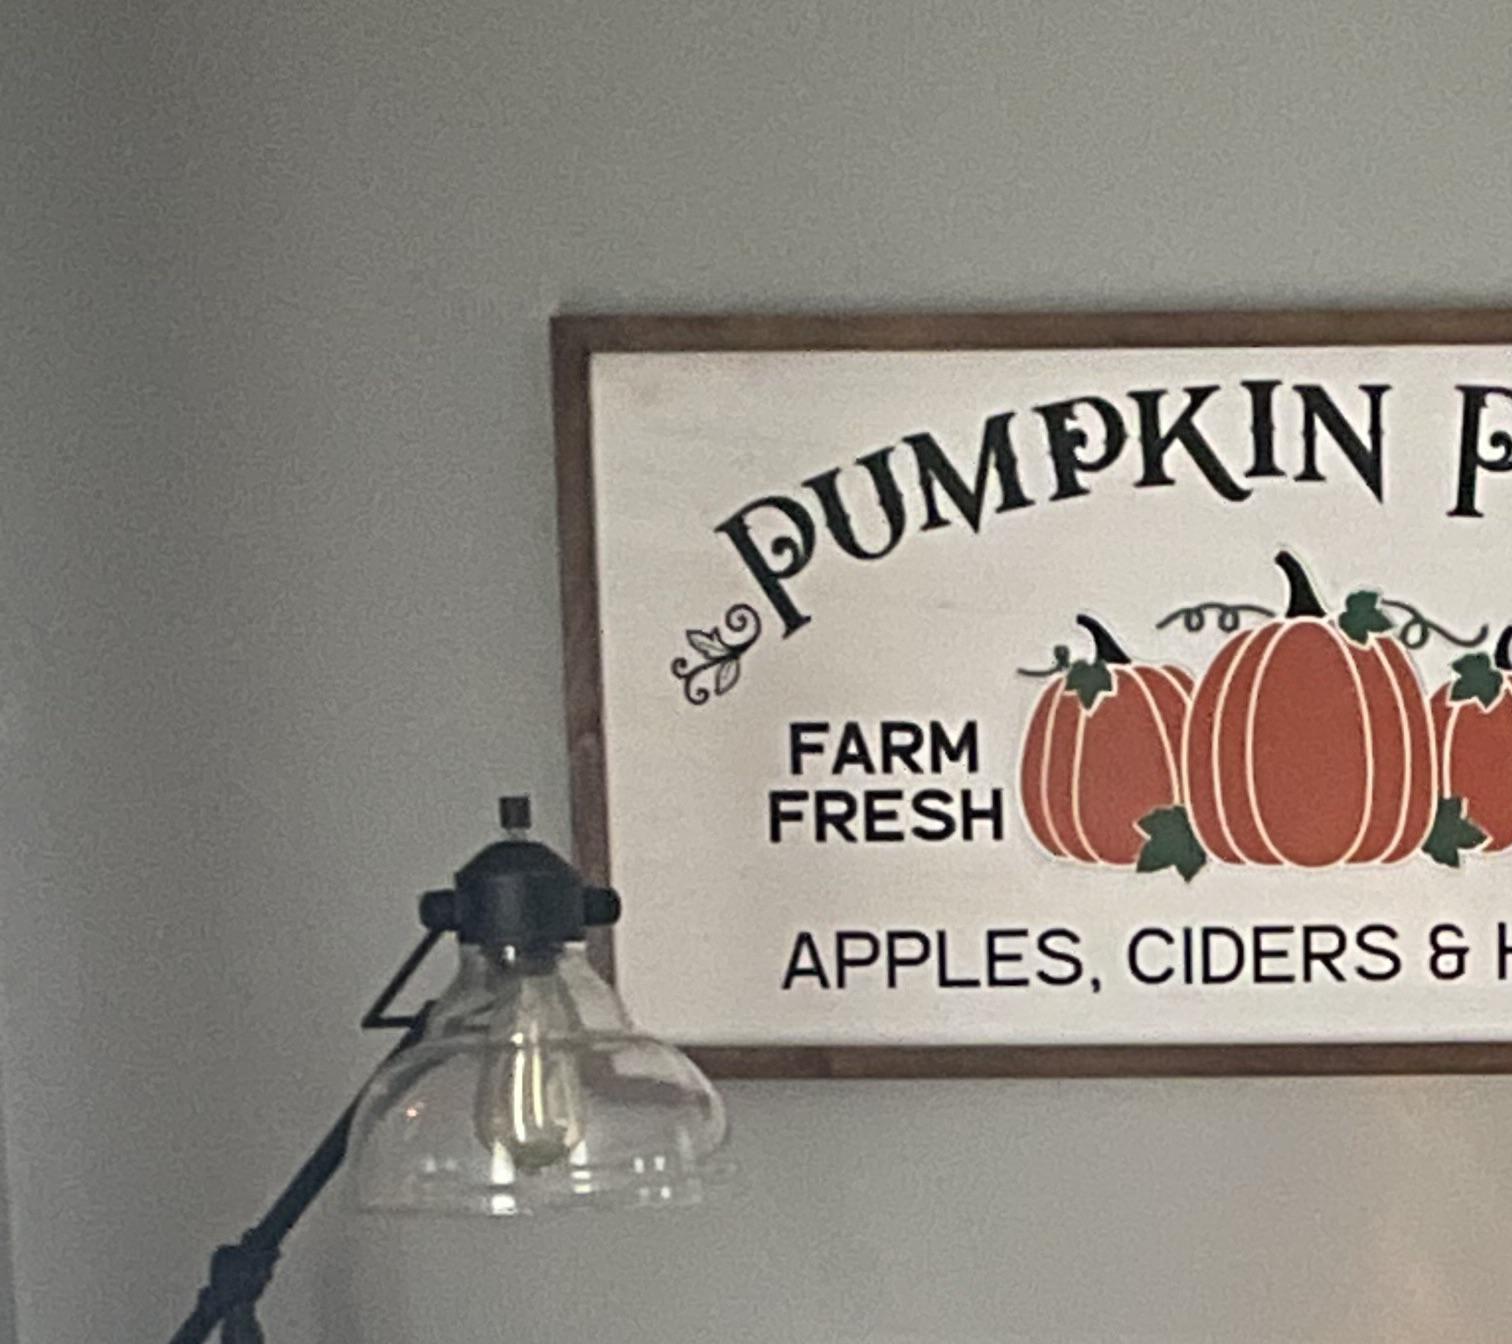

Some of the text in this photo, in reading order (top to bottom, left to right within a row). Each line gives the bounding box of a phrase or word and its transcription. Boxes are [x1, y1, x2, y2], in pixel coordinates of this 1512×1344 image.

[713, 378, 1394, 640] PUMPKIN
[788, 719, 980, 777] FARM
[767, 787, 1004, 845] FRESH
[780, 927, 1102, 994] APPLES,
[1127, 923, 1402, 986] CIDERS
[1428, 922, 1471, 981] &
